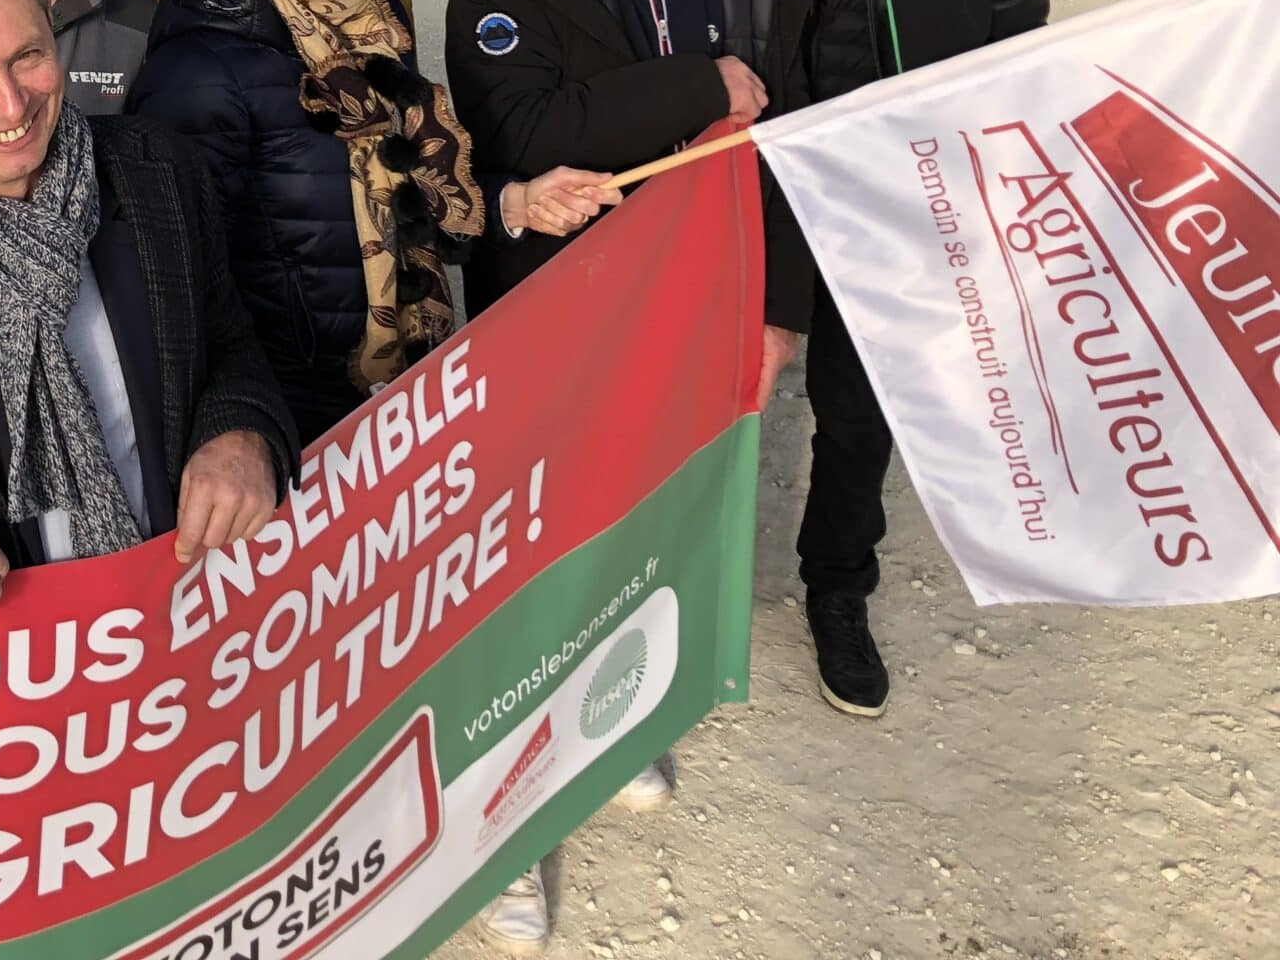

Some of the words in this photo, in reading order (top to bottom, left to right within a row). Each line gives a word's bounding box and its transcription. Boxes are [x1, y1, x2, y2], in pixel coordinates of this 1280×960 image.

[69, 71, 124, 84] FENDT
[100, 84, 125, 95] Profi
[909, 136, 962, 235] Demain
[944, 241, 969, 268] se
[1129, 160, 1280, 387] Jeun
[956, 276, 1007, 378] construit
[999, 170, 1213, 568] Agriculteurs
[170, 337, 487, 653] ENSEMBLE,
[526, 457, 545, 542] !
[988, 388, 1056, 541] aujourd'hui
[207, 440, 476, 710] SOMMES
[463, 556, 660, 743] votonslebonsens.fr
[161, 836, 341, 960] OTONS
[276, 839, 386, 950] SENS
